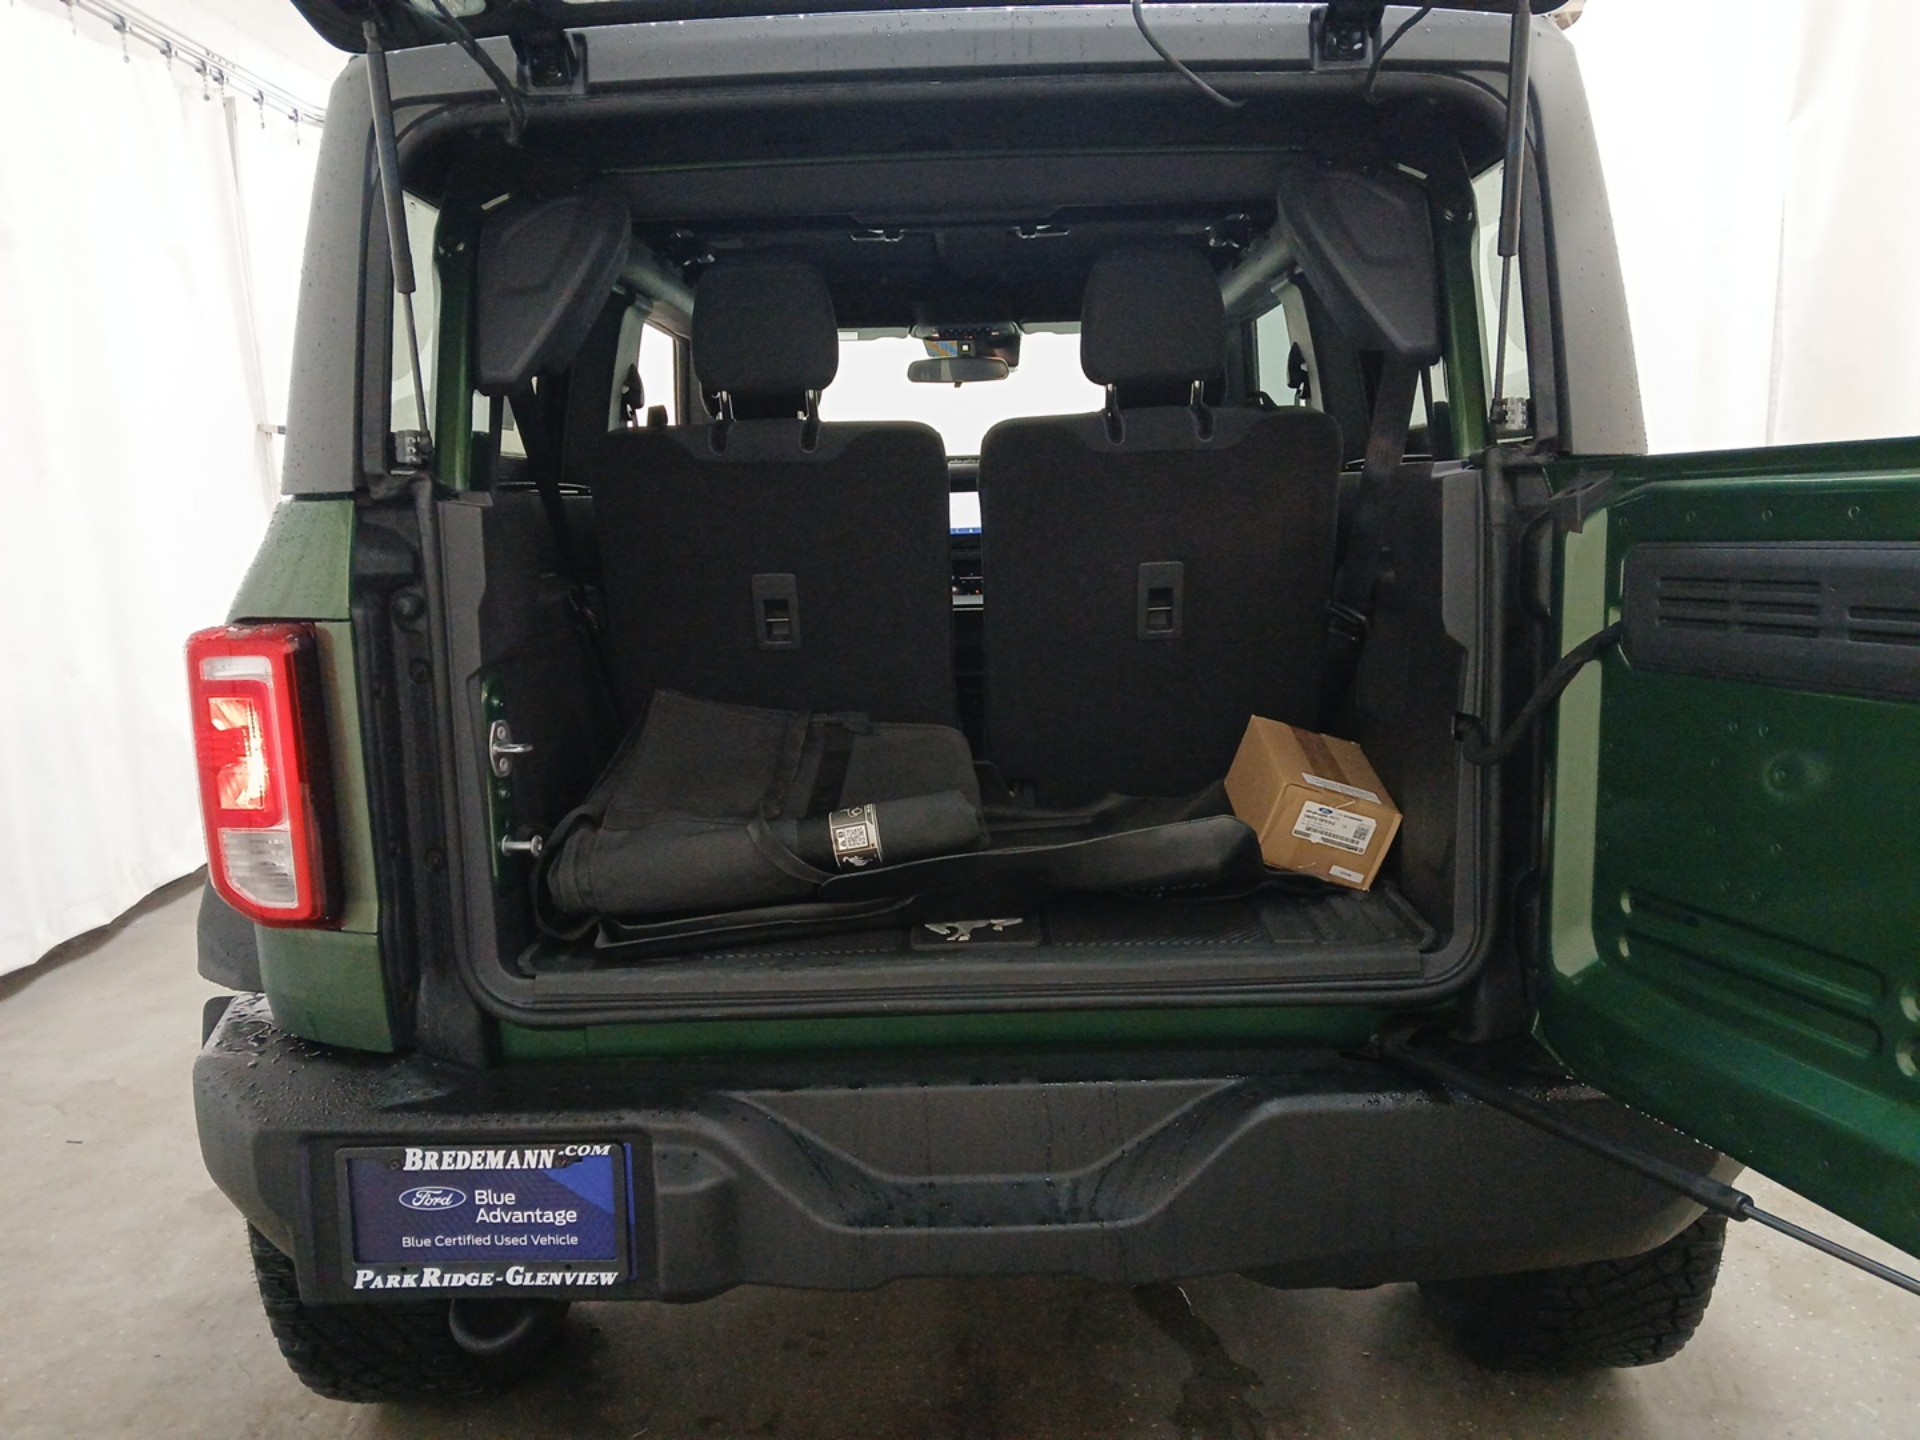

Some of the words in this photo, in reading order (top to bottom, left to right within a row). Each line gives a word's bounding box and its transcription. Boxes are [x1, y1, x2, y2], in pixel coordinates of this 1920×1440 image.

[412, 1189, 453, 1207] Ford
[474, 1190, 516, 1205] Blue
[476, 1208, 577, 1226] Advantage
[402, 1236, 431, 1248] Blue
[434, 1234, 491, 1247] Certified
[494, 1234, 528, 1246] Used
[531, 1234, 578, 1246] Vehicle
